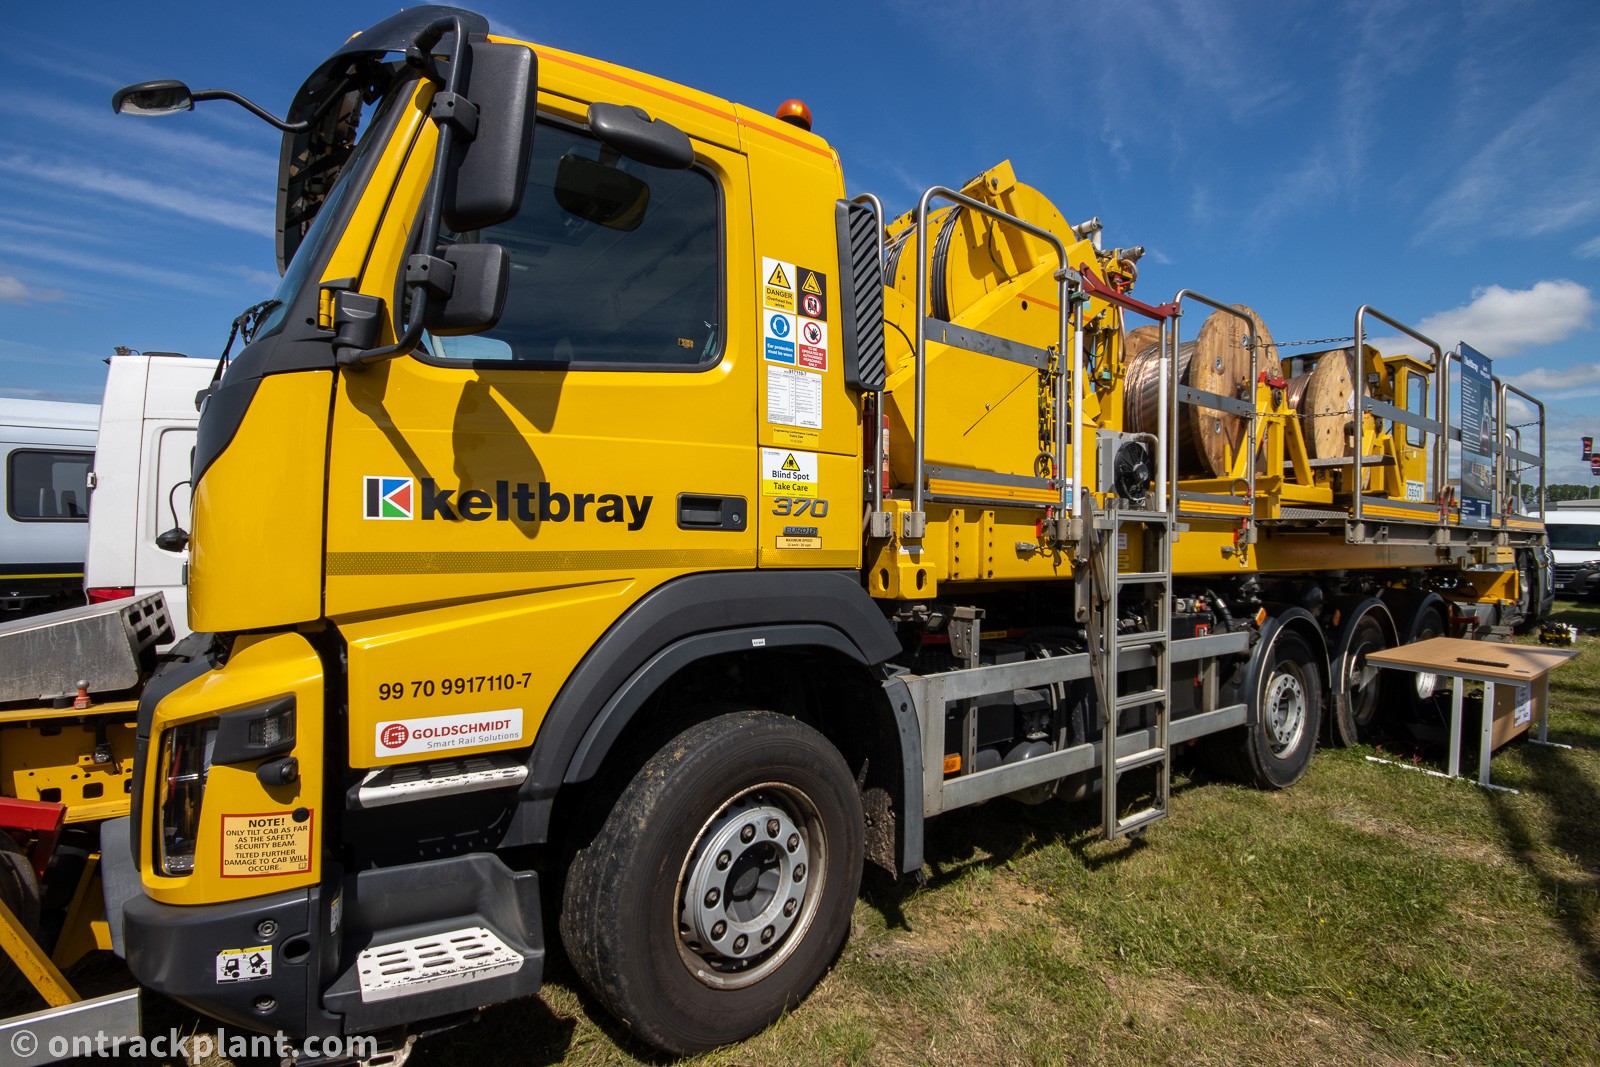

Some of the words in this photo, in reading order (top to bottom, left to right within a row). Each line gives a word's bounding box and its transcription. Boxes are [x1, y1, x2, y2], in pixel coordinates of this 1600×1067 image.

[766, 287, 793, 300] DANGER
[766, 295, 786, 304] Overhead
[774, 344, 794, 353] protection
[772, 470, 792, 479] Blind
[792, 472, 810, 481] Spot
[774, 482, 790, 490] Take
[792, 483, 808, 492] Care
[421, 478, 654, 531] keltbray
[772, 496, 828, 518] 370
[378, 682, 404, 700] 99
[410, 680, 435, 698] 70
[441, 672, 532, 696] 9917110-7
[412, 720, 512, 740] GOLDSCHMIDT
[427, 740, 456, 749] Smart
[458, 736, 476, 745] Rail
[478, 731, 519, 742] Solutions
[248, 818, 285, 828] NOTE!
[266, 834, 294, 842] SAFETY
[234, 842, 270, 850] SECURITY
[272, 840, 297, 848] BEAM.
[262, 848, 296, 858] FURTHER
[290, 854, 308, 862] WILL
[248, 864, 282, 872] OCCURE.
